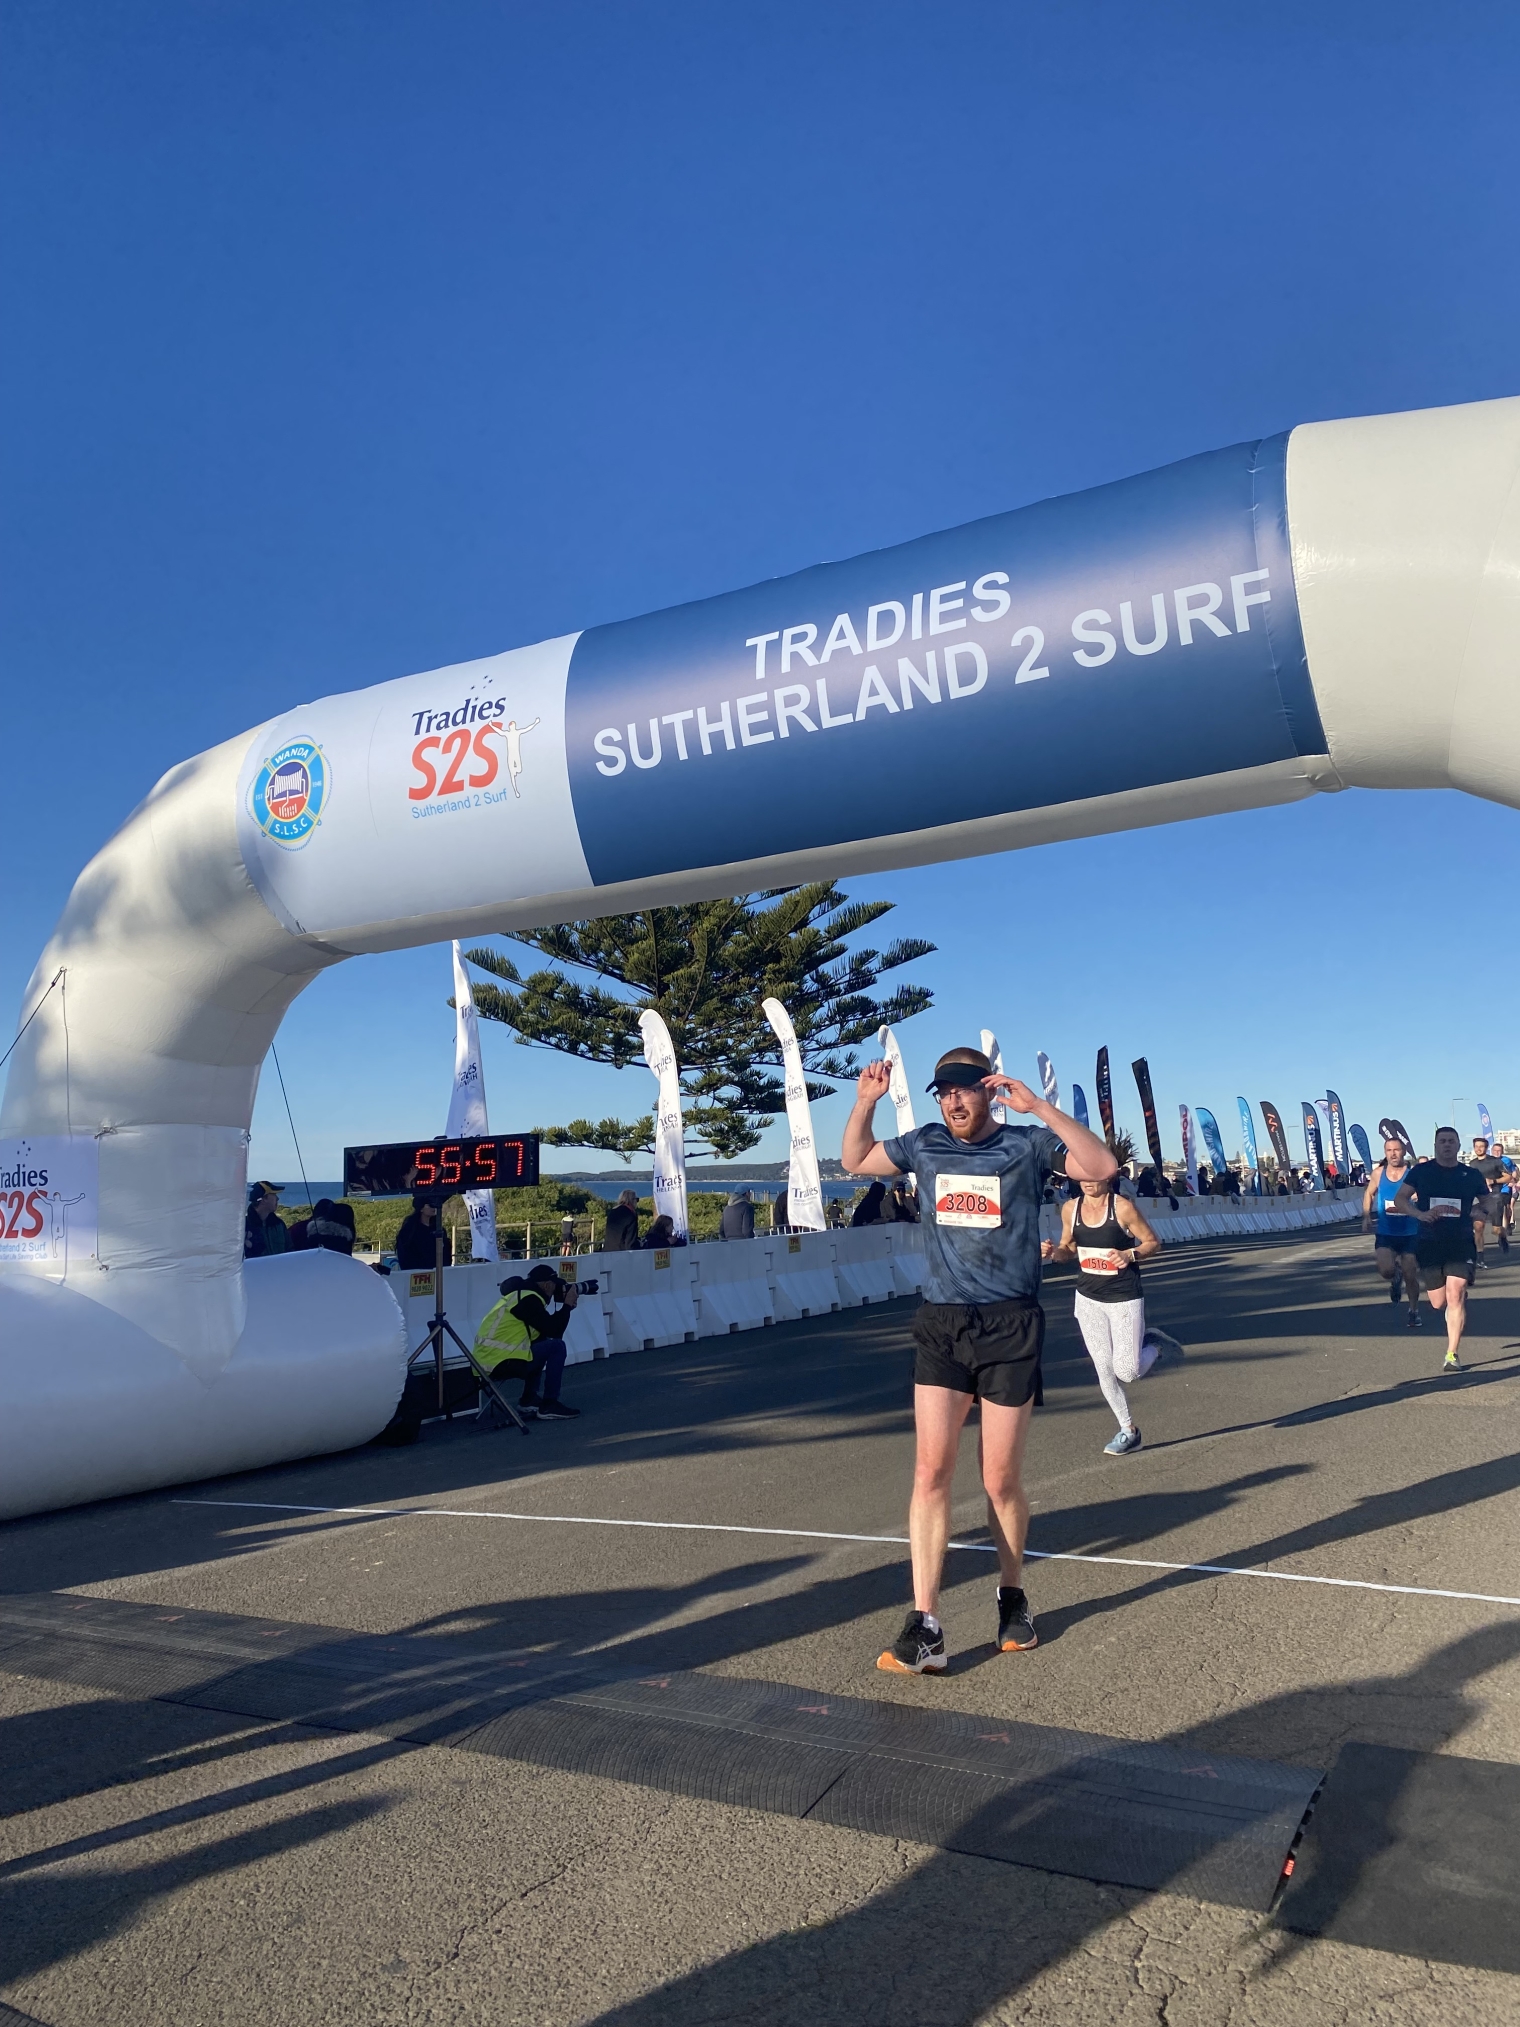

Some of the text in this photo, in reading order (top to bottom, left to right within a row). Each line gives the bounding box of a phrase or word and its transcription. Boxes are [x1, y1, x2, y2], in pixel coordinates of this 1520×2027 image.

[745, 571, 1012, 680] TRADIES
[593, 567, 1273, 777] SUTHERLAND 2 SURF
[411, 697, 506, 736] Tradies
[274, 747, 309, 764] WANDA
[408, 721, 503, 801] S2S
[411, 788, 507, 819] Sutherland 2 Surf
[1307, 1125, 1318, 1177] MARTINUS
[1332, 1112, 1344, 1162] MARTINUS
[0, 1163, 48, 1189] radies
[971, 1184, 994, 1192] Tradies
[946, 1193, 987, 1213] 3208
[21, 1243, 27, 1252] 2
[28, 1241, 46, 1252] Surf
[1087, 1258, 1108, 1270] 1516
[413, 1274, 431, 1285] TFH
